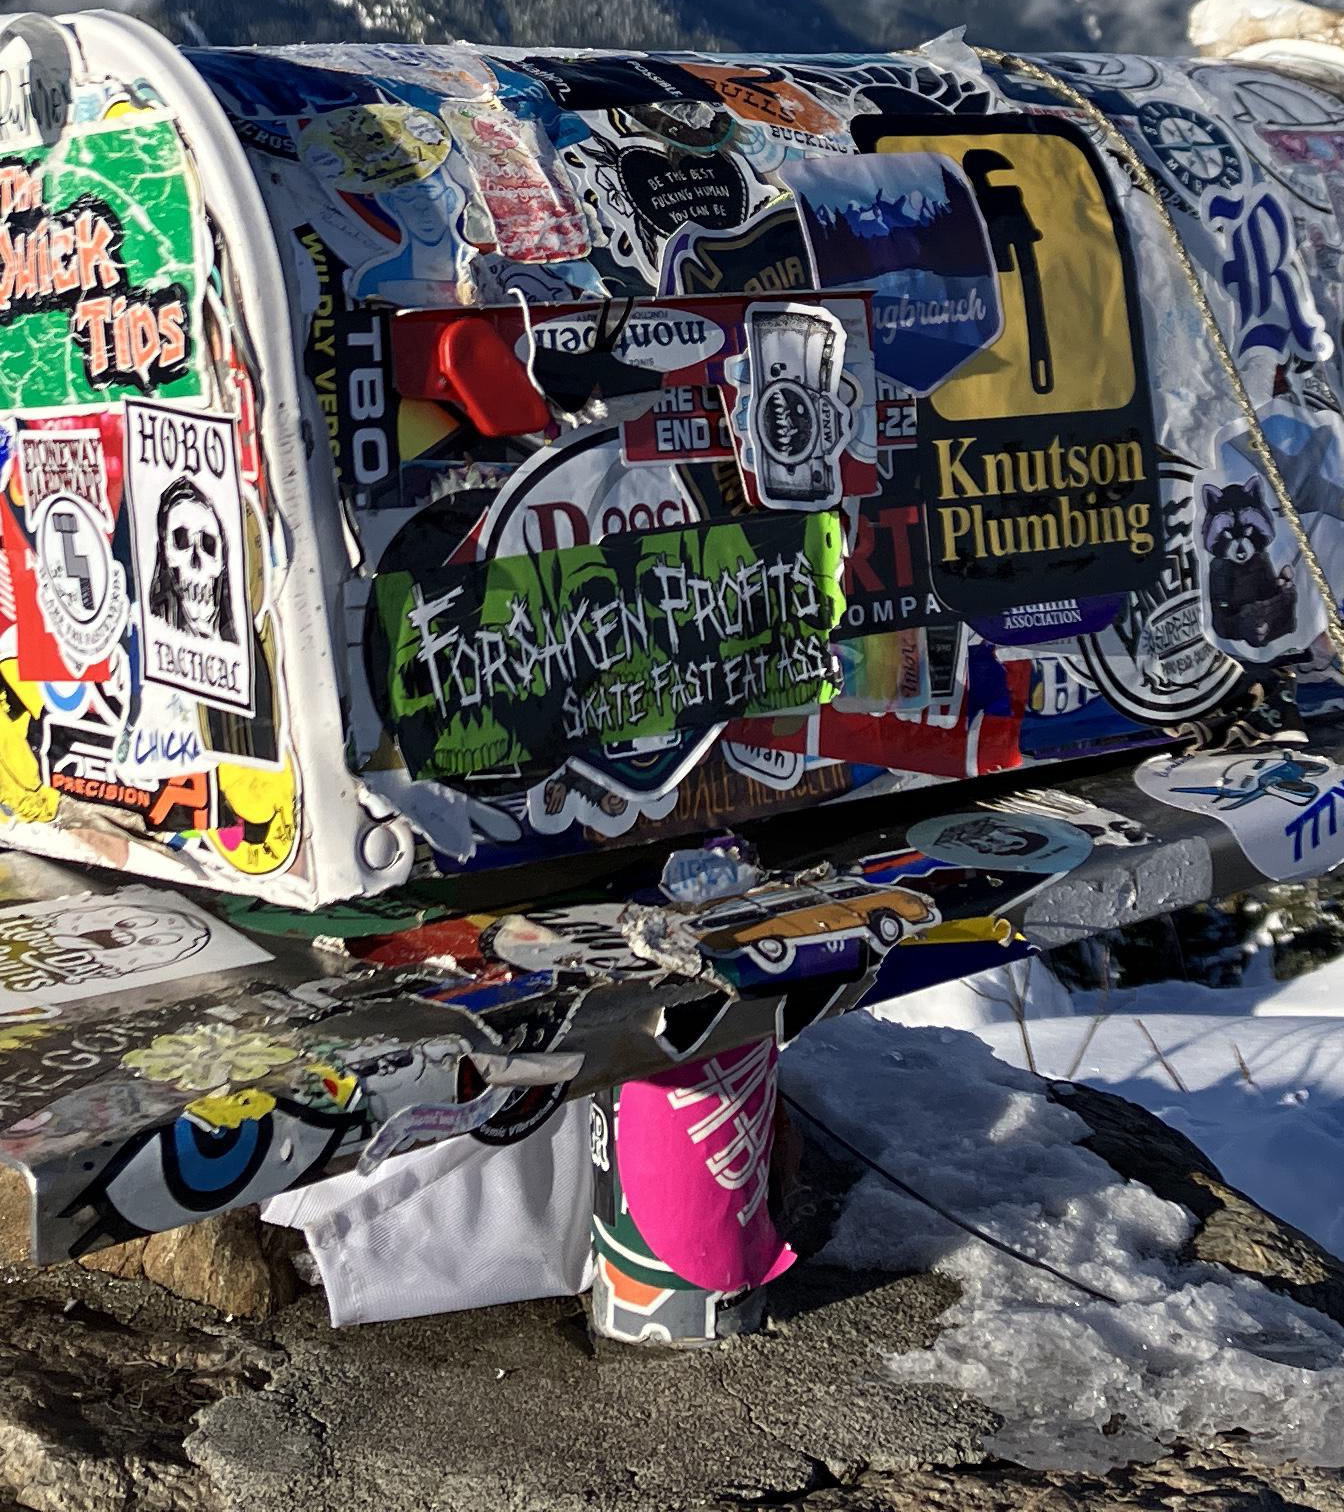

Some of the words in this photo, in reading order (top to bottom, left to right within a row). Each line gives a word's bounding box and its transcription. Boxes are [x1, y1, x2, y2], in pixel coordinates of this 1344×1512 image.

[648, 176, 664, 191] BE
[665, 170, 687, 183] THE
[689, 168, 716, 180] BEST
[651, 188, 693, 210] FUCKING
[694, 185, 730, 199] HUMAN
[669, 209, 689, 224] YOU
[689, 205, 709, 218] CAN
[712, 204, 727, 217] BE
[138, 411, 226, 479] HOBO
[657, 416, 711, 452] END
[932, 434, 1147, 501] Knutson
[937, 491, 1155, 562] Plumbing
[1003, 609, 1083, 630] ASSOCIATION
[154, 641, 241, 694] TACTICAL
[561, 678, 647, 739] SKATE
[650, 656, 718, 716] FAST
[721, 650, 771, 706] EAT
[775, 634, 828, 688] ASS
[52, 772, 151, 808] PRECISION
